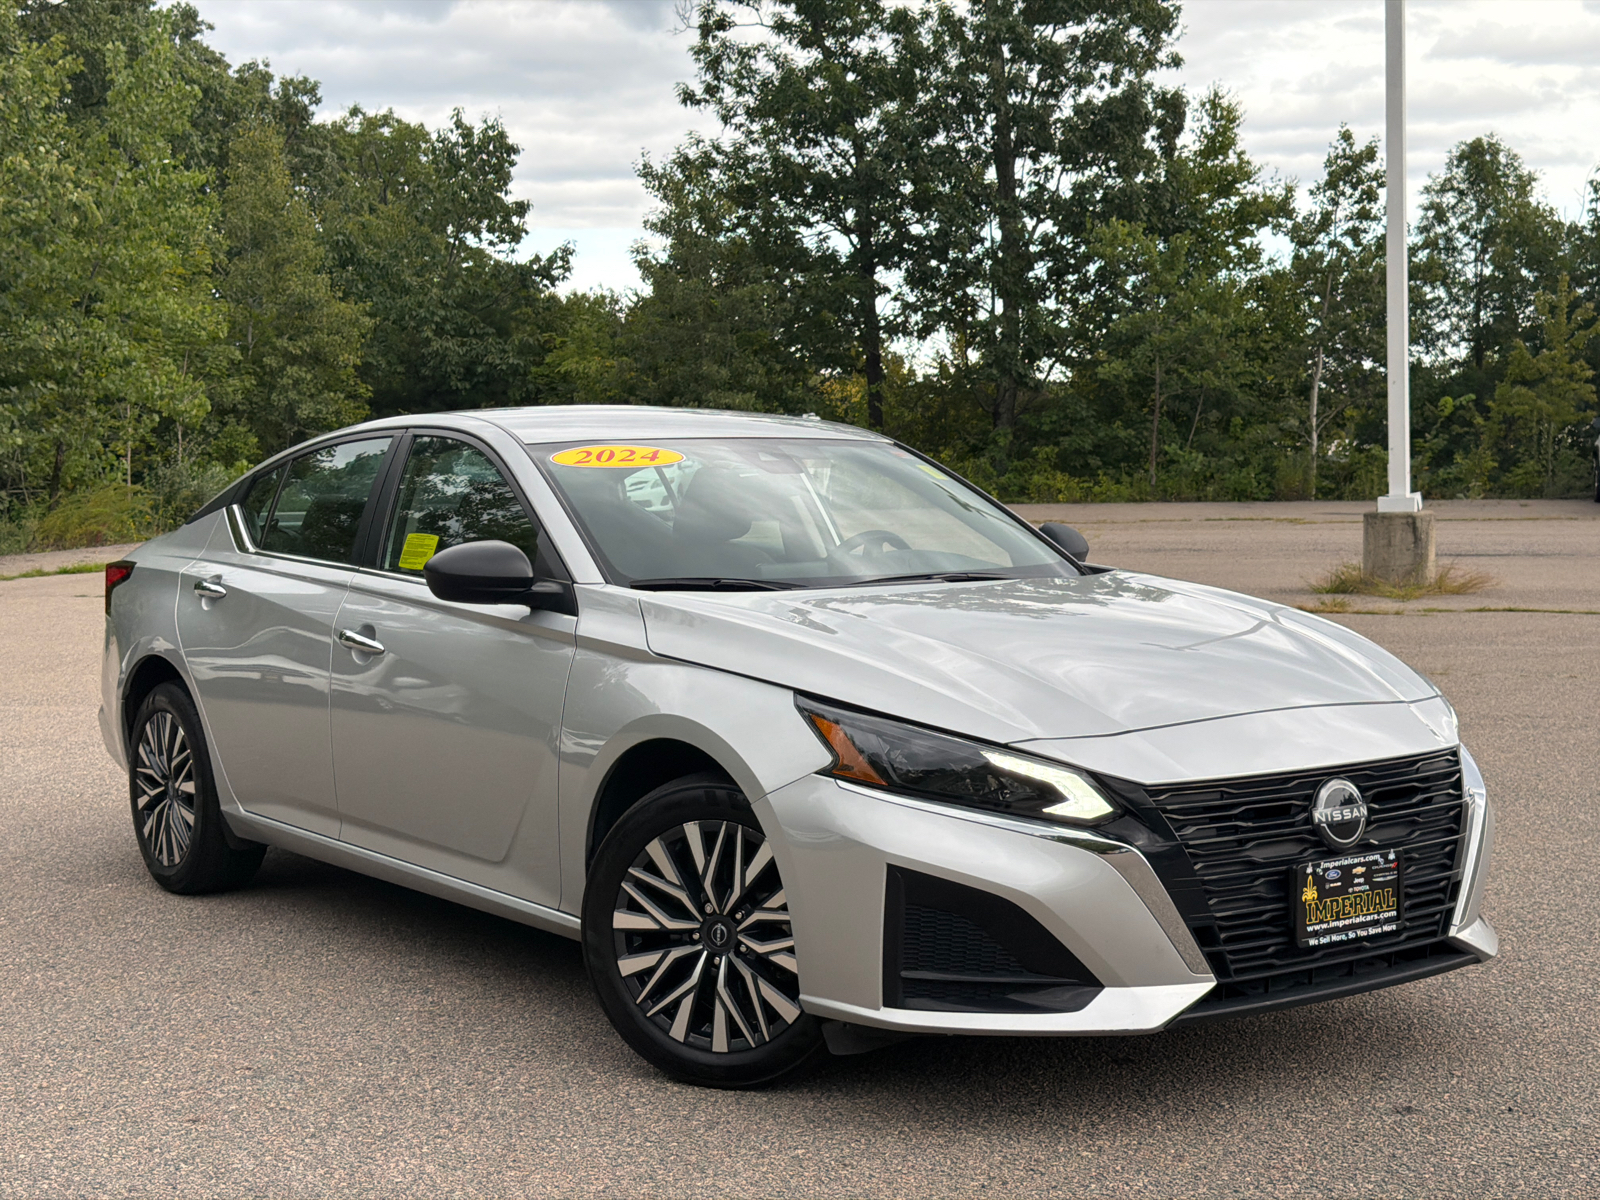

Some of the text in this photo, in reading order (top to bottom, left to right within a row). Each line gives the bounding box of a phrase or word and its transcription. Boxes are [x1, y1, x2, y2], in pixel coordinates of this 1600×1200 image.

[573, 449, 661, 465] 2024
[1314, 805, 1368, 823] NISSAN
[1306, 888, 1397, 925] IMPERIAL
[1306, 910, 1397, 932] www.imperialcars.com
[1308, 938, 1319, 947] We
[1319, 935, 1331, 944] Sell
[1348, 931, 1356, 939] So
[1357, 928, 1368, 938] You
[1368, 925, 1382, 935] Save
[1382, 923, 1397, 932] More
